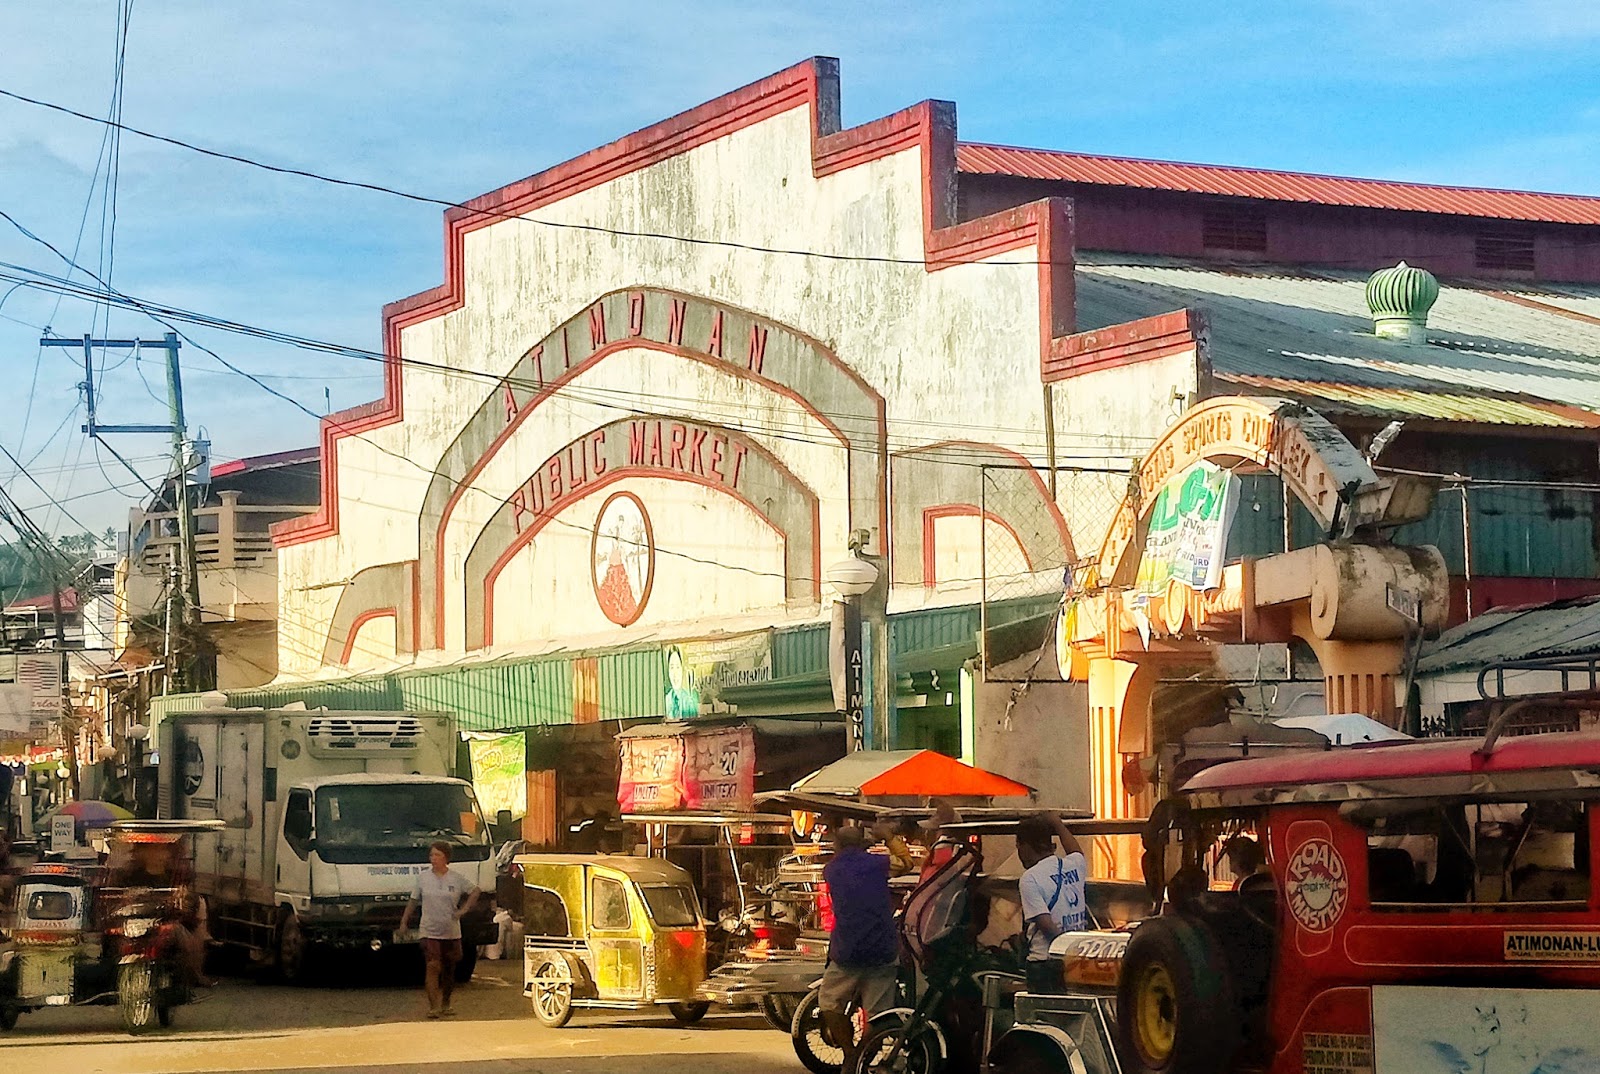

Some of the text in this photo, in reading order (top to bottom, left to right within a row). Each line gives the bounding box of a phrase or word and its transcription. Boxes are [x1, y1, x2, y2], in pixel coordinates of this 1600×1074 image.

[503, 291, 769, 423] ATIMONAN
[1182, 410, 1232, 455] SPORTS
[512, 421, 748, 534] PUBLIC MARKET
[720, 751, 739, 777] 20
[54, 821, 72, 829] ONE
[1290, 842, 1342, 880] ROAD
[1291, 890, 1346, 929] MASTER
